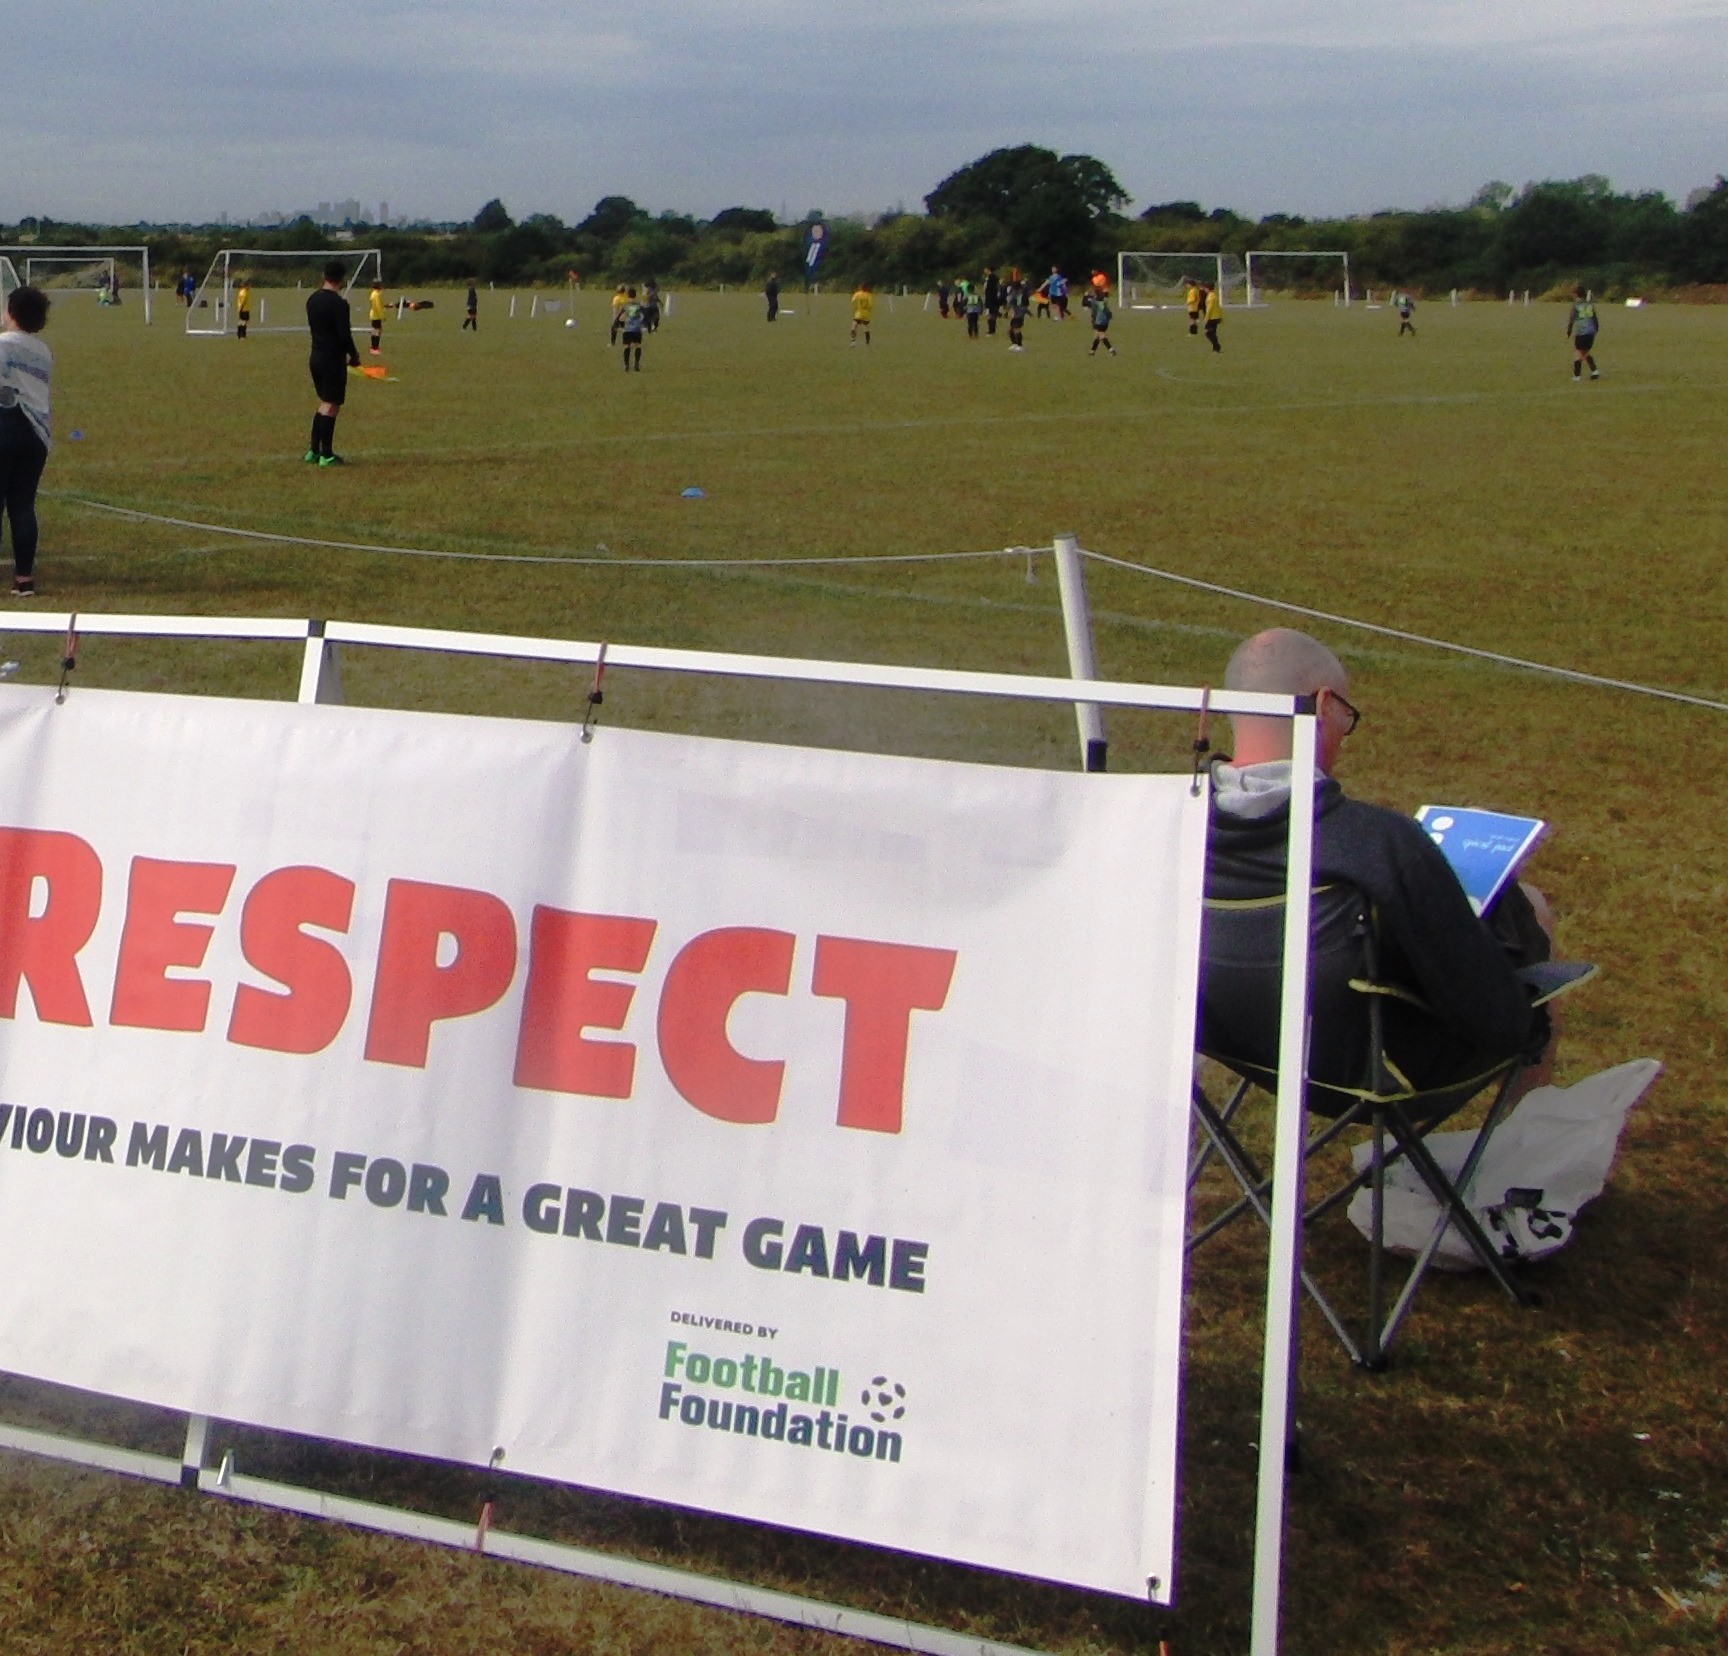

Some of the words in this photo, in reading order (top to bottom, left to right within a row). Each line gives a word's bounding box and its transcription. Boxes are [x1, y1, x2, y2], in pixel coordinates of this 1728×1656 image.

[125, 1121, 316, 1194] MAKES
[328, 1151, 450, 1217] FOR
[460, 1172, 506, 1227] A
[521, 1182, 729, 1260] GREAT
[742, 1217, 930, 1294] GAME
[669, 1310, 754, 1336] DELIVERED
[757, 1325, 779, 1340] BY
[663, 1340, 840, 1407] Football
[658, 1381, 904, 1463] Foundation
